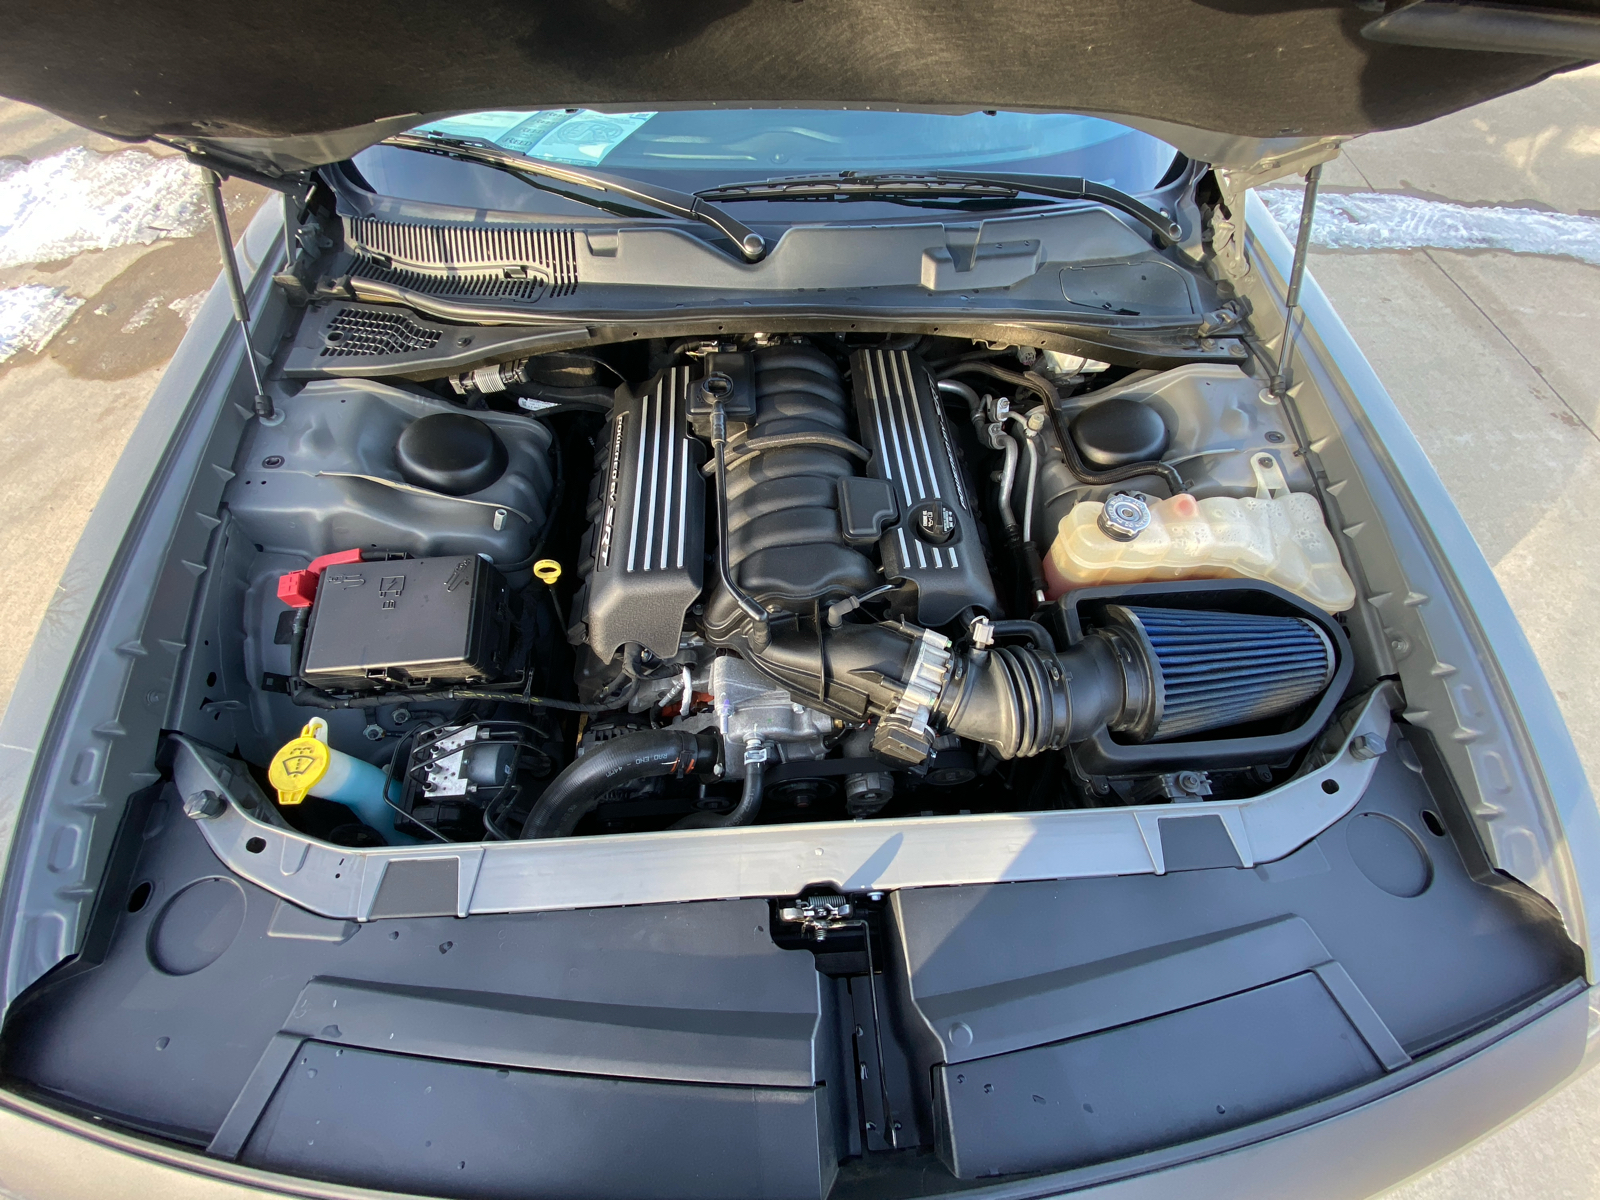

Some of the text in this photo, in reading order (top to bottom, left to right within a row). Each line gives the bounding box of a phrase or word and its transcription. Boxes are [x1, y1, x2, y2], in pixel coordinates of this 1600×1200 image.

[602, 416, 622, 566] POWERED BY SRT
